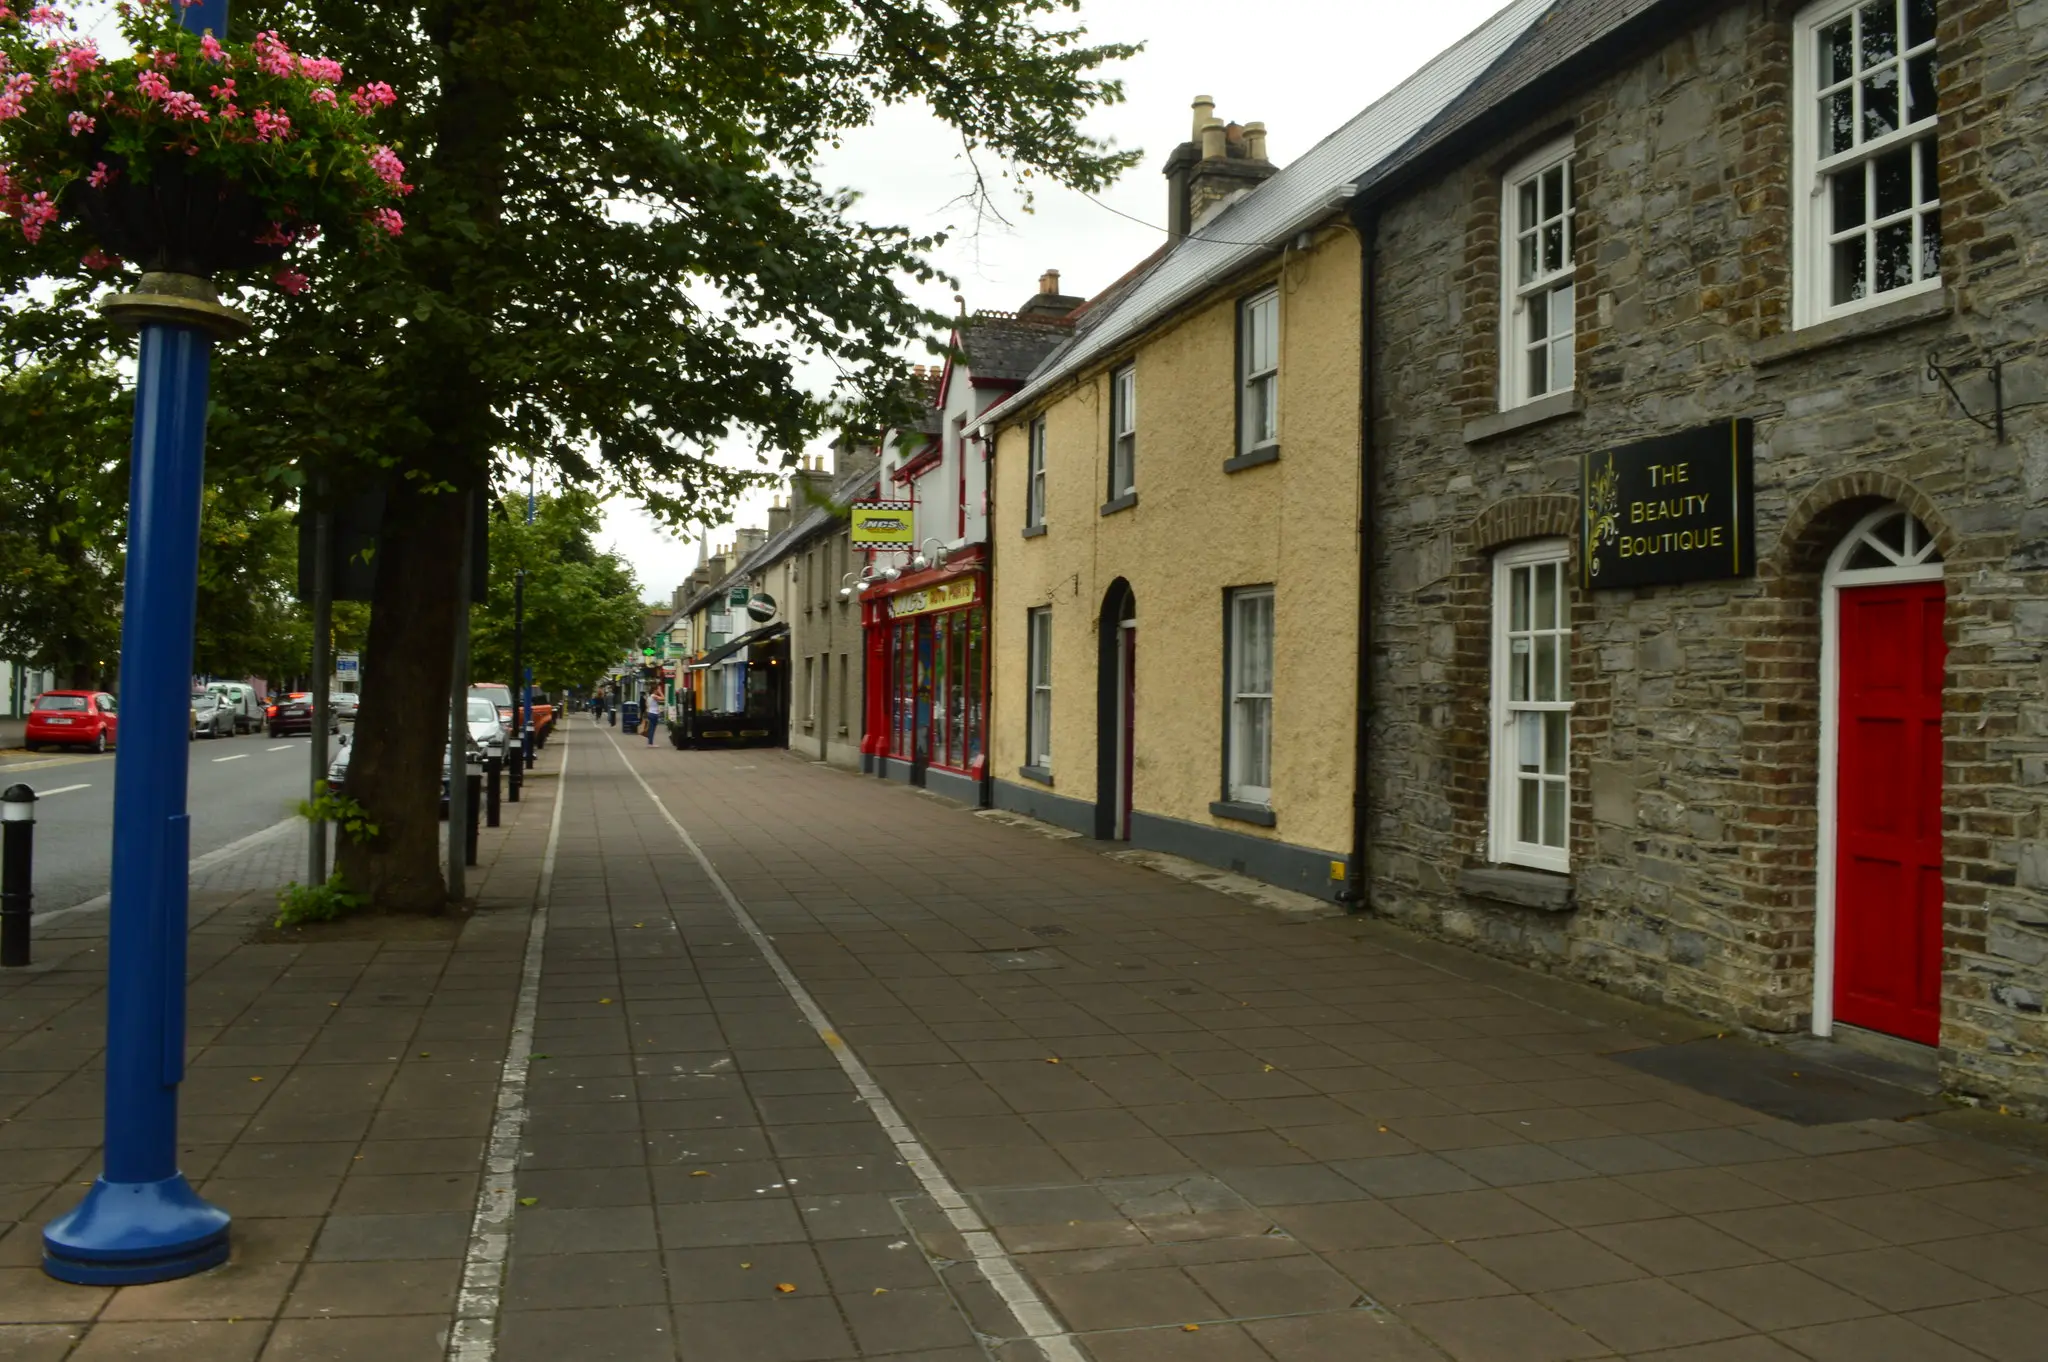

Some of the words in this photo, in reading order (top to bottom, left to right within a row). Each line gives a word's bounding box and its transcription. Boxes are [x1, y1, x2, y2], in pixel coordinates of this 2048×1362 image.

[1648, 462, 1689, 488] THE
[1631, 493, 1710, 524] BEAUTY
[866, 520, 899, 528] NCS
[1619, 526, 1723, 558] BOUTIQUE
